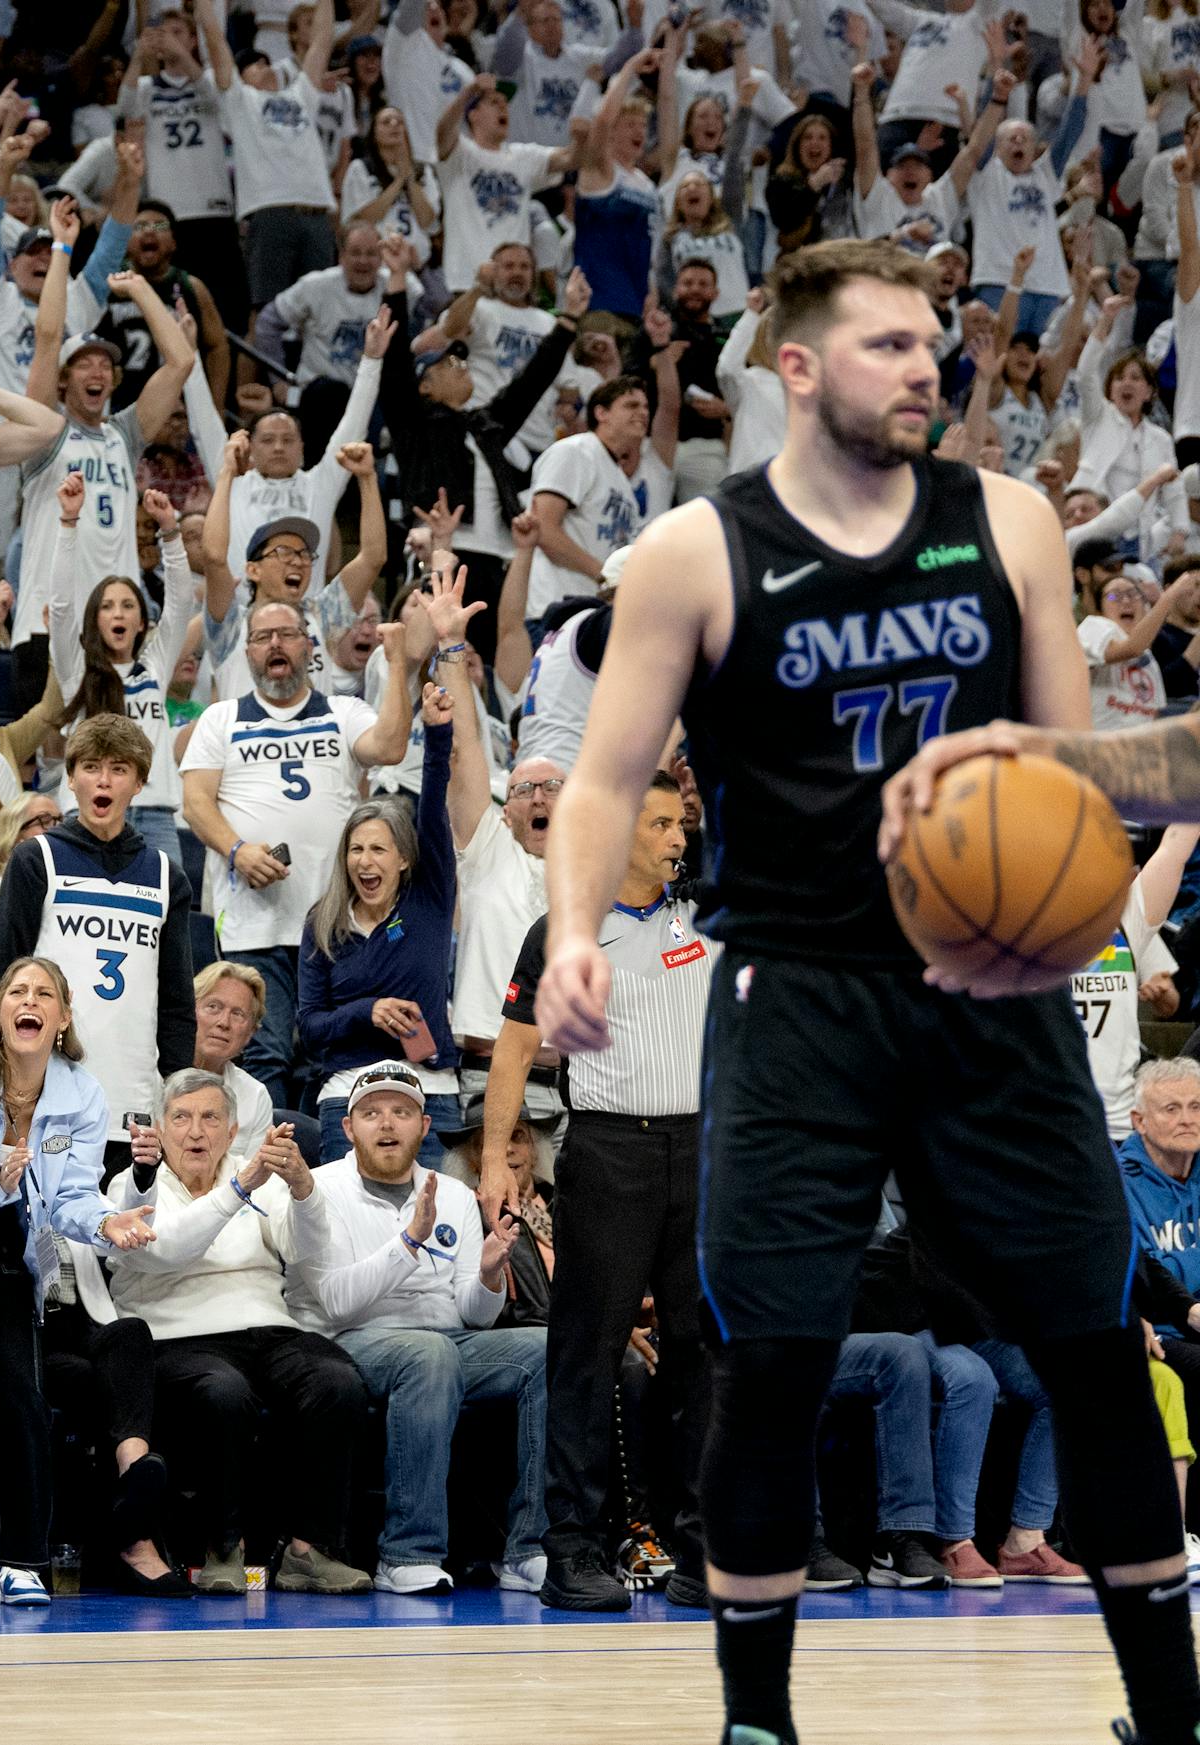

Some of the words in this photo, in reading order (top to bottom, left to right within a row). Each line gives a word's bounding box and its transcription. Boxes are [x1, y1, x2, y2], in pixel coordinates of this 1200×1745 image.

[164, 120, 203, 148] 32
[98, 495, 114, 528] 5
[916, 543, 980, 572] chime
[779, 594, 990, 689] MAVS
[833, 674, 959, 774] 77
[239, 739, 341, 763] WOLVES
[280, 760, 311, 801] 5
[56, 915, 160, 949] WOLVES
[93, 948, 128, 1001] 3
